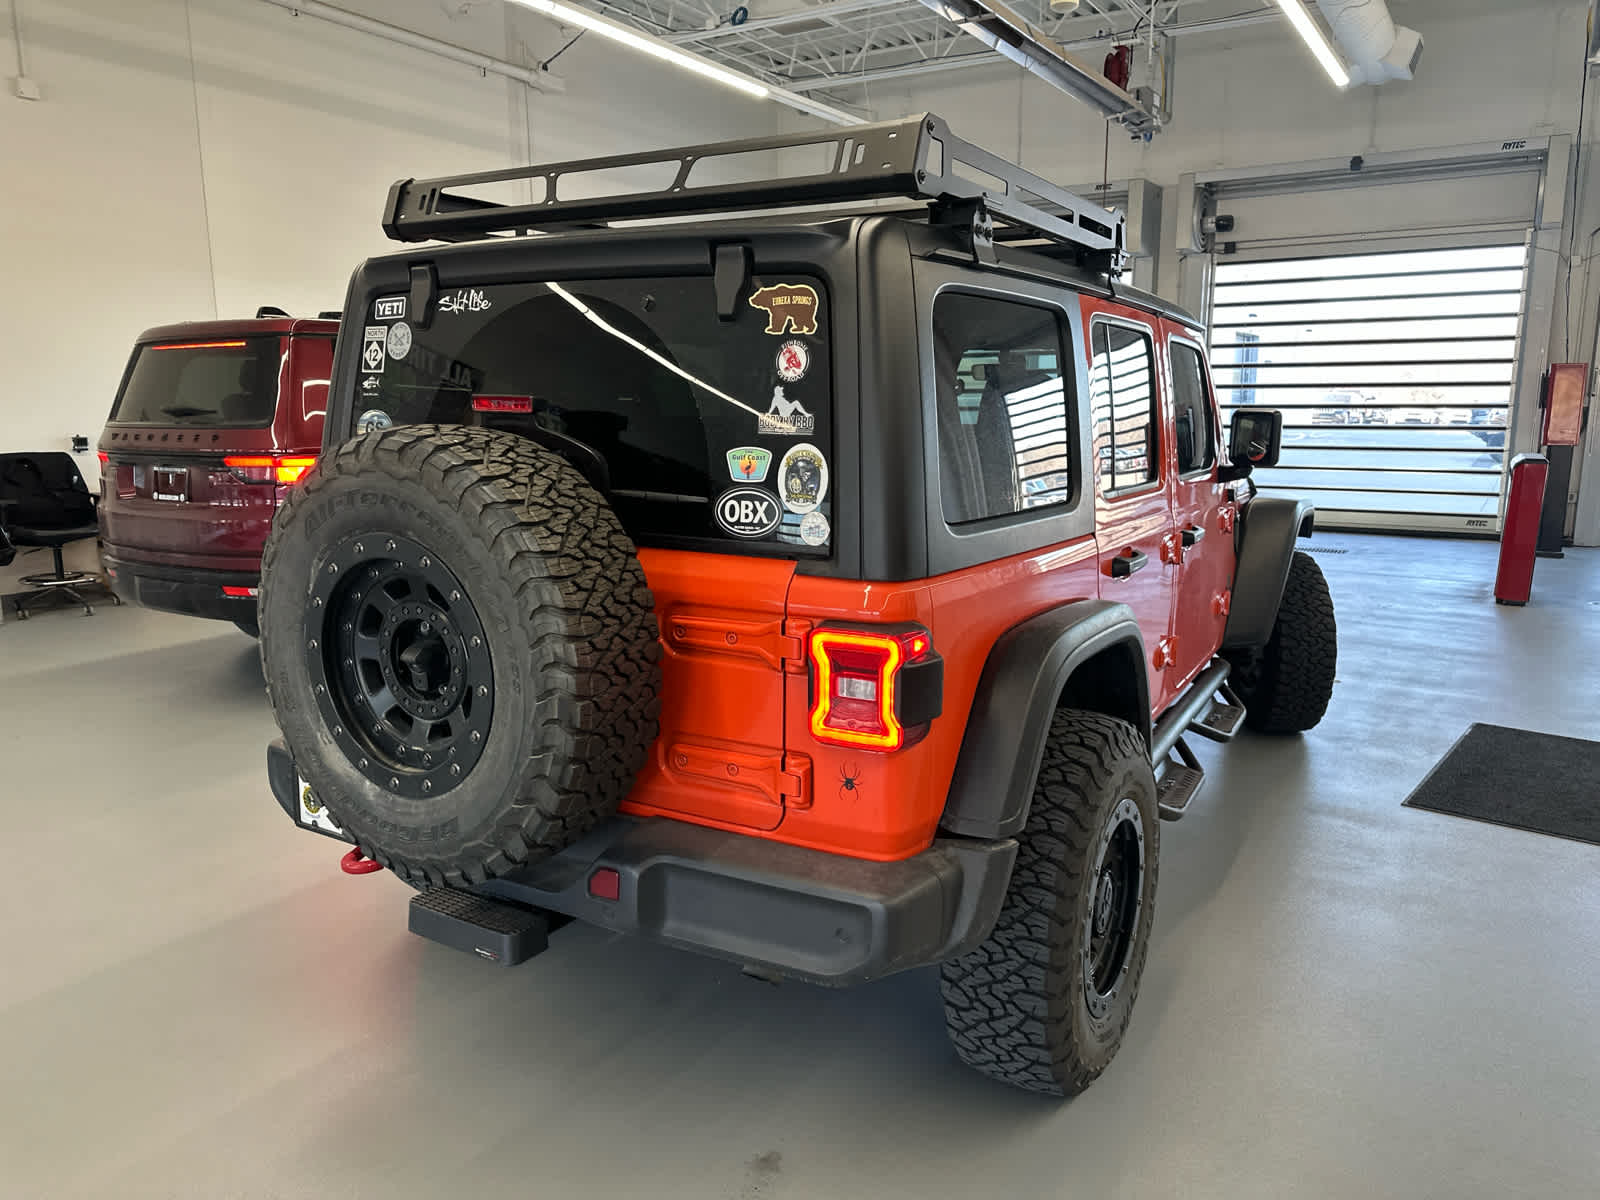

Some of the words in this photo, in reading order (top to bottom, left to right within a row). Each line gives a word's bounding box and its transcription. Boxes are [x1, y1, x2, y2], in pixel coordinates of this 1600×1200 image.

[1501, 141, 1526, 150] RYTEC
[377, 302, 403, 316] YETI
[369, 348, 379, 362] 12
[732, 453, 746, 461] Gulf
[724, 499, 769, 524] OBX
